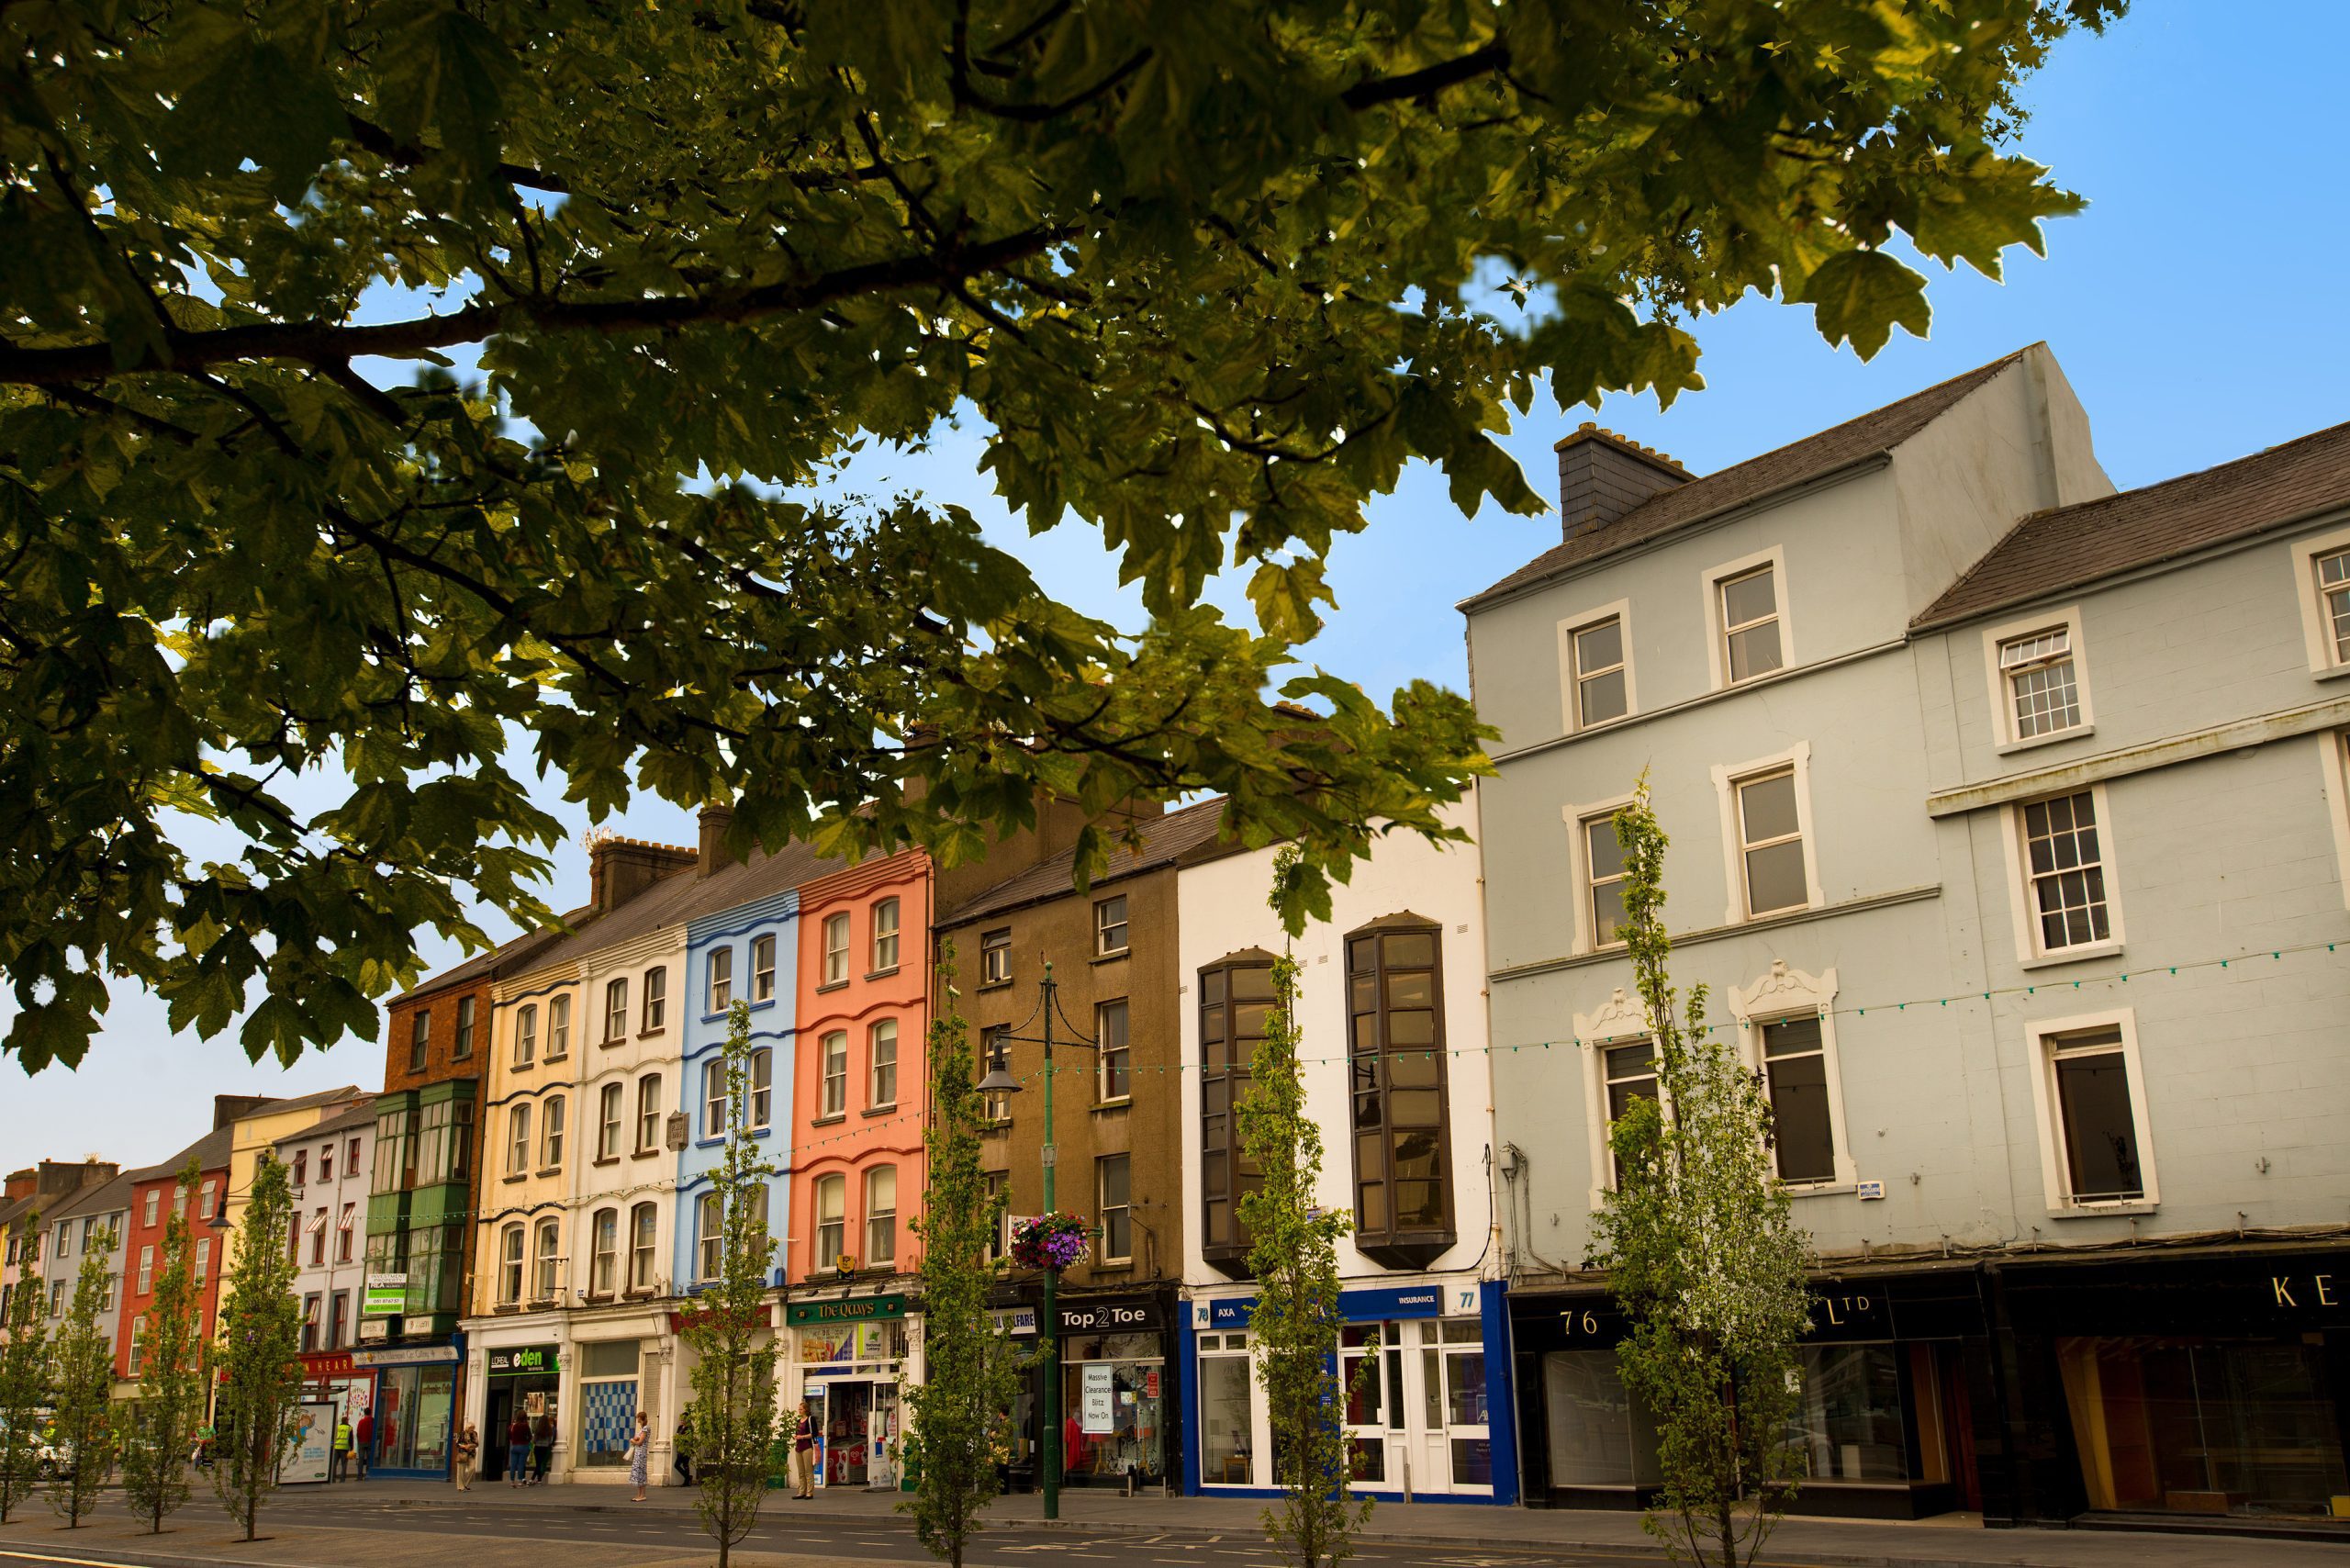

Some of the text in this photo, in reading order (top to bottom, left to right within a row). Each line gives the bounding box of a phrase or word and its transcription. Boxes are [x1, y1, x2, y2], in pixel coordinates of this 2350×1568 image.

[1398, 1295, 1435, 1305] INSURANCE
[1460, 1292, 1474, 1308] 77
[1197, 1307, 1208, 1322] 78
[1218, 1308, 1235, 1317] AXA
[1560, 1310, 1597, 1335] 76
[513, 1348, 543, 1368] eden
[1091, 1398, 1104, 1406] Blitz
